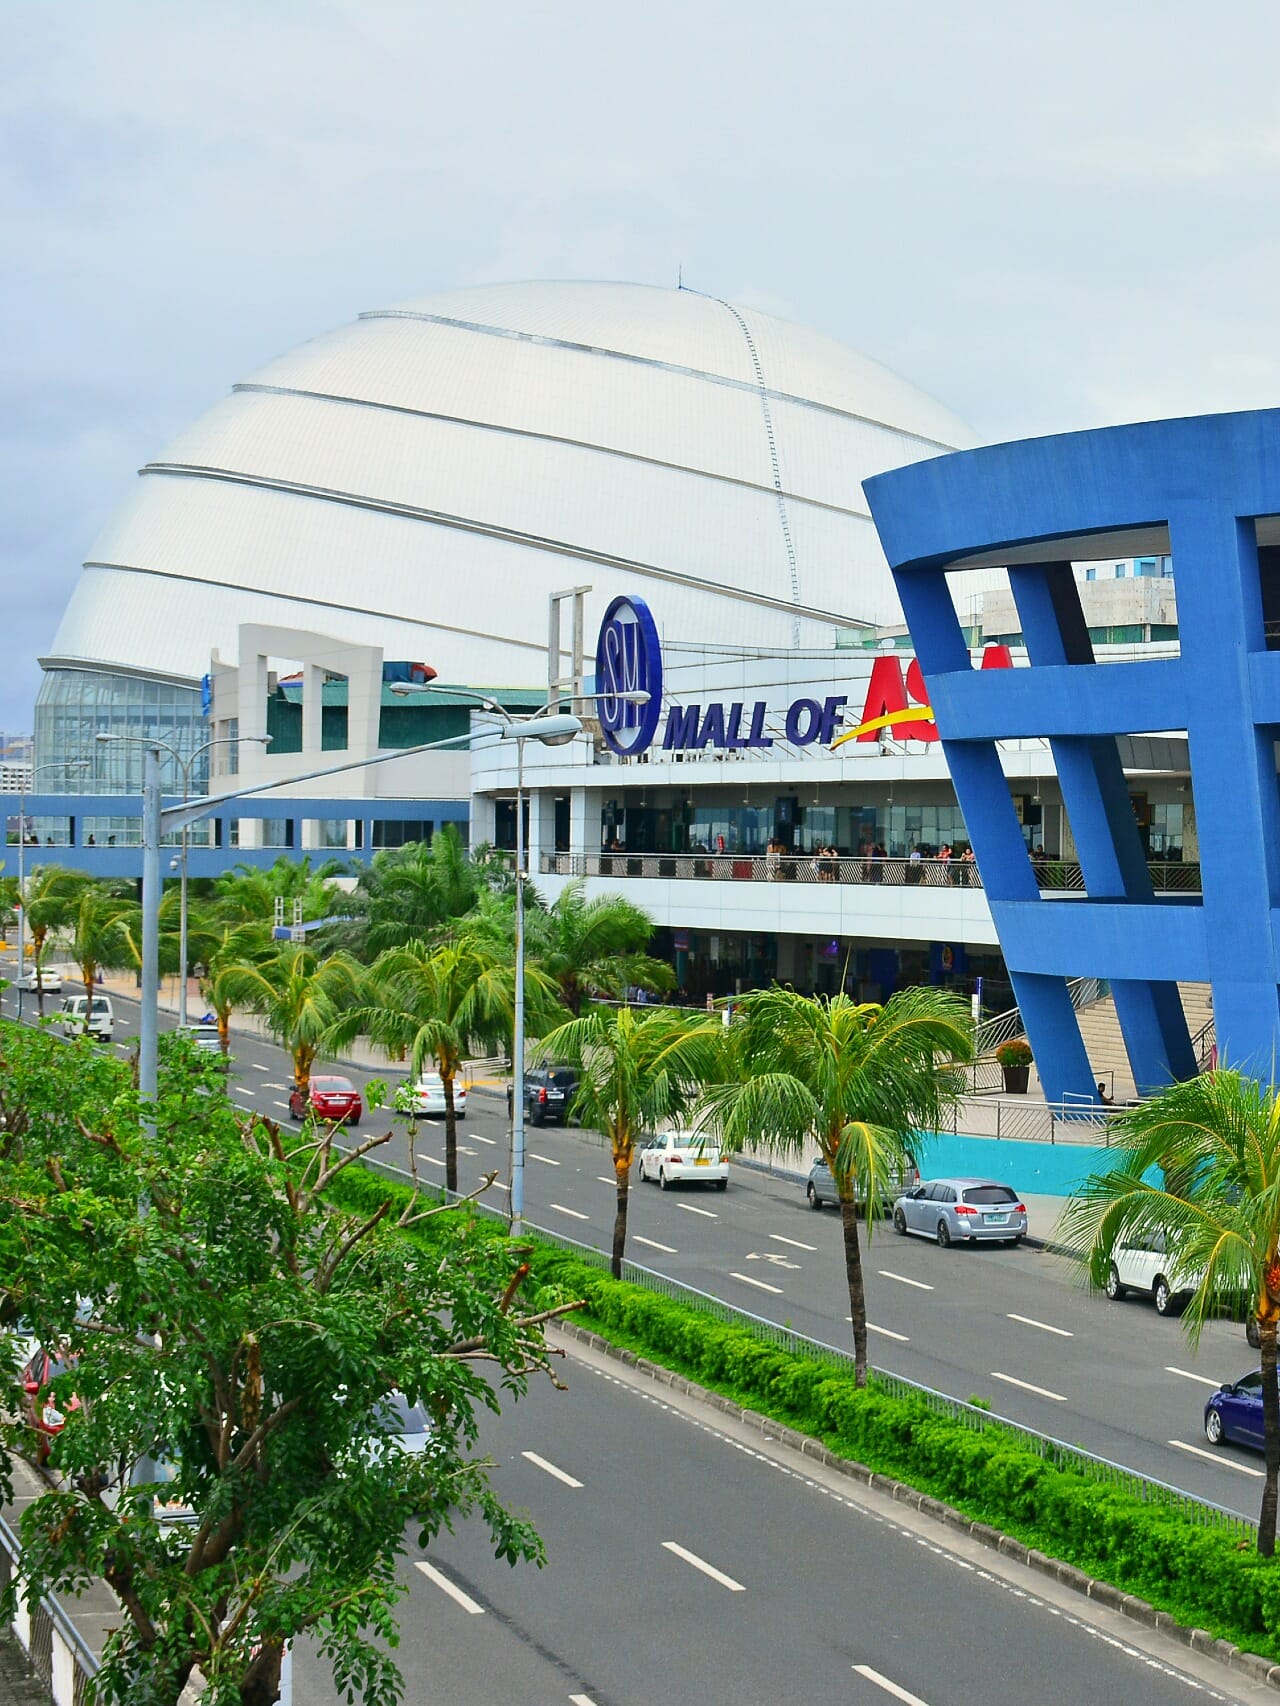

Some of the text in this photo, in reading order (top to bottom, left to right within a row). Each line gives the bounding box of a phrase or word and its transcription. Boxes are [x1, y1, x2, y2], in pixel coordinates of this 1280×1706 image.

[598, 620, 649, 731] SM
[662, 701, 774, 750] MALL
[785, 695, 848, 747] OF
